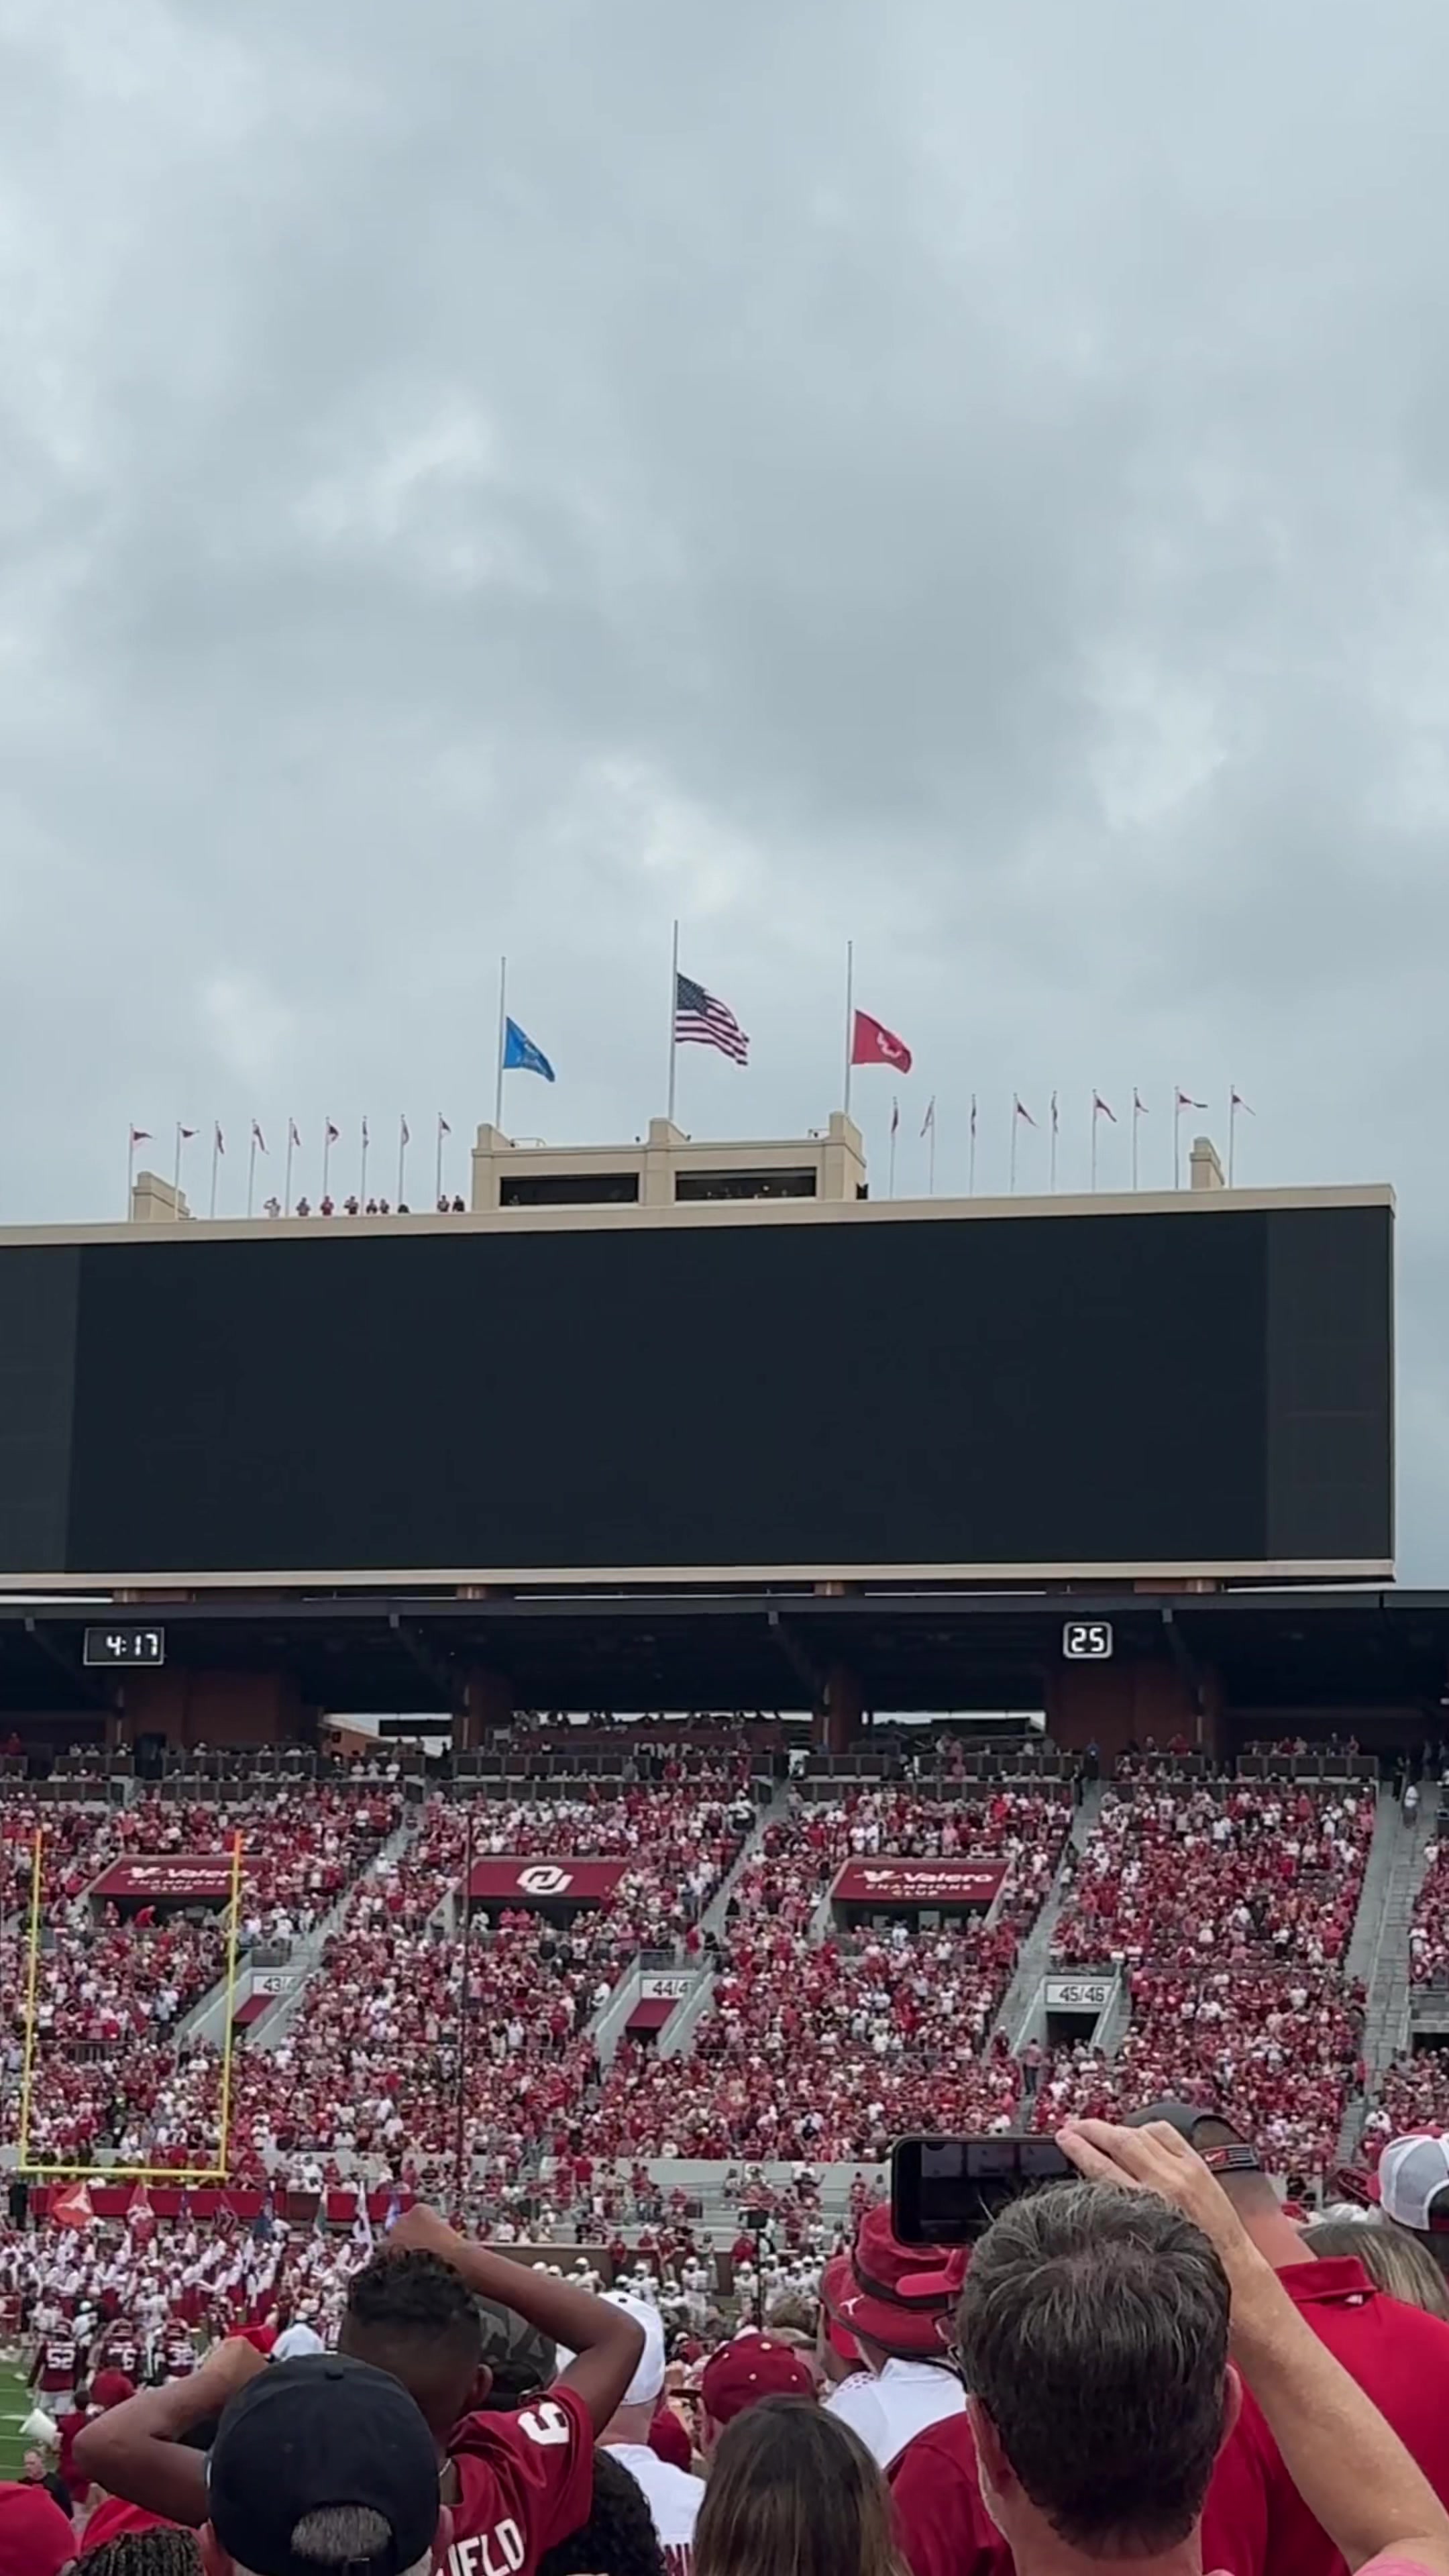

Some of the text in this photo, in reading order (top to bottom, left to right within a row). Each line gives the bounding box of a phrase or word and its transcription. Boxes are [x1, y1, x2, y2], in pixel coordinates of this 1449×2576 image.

[107, 1633, 158, 1656] 4:17
[1071, 1627, 1104, 1652] 25
[904, 1872, 994, 1883] Valero
[1059, 1986, 1105, 2002] 45/46
[46, 2348, 75, 2369] 52
[435, 2518, 525, 2576] IELD
